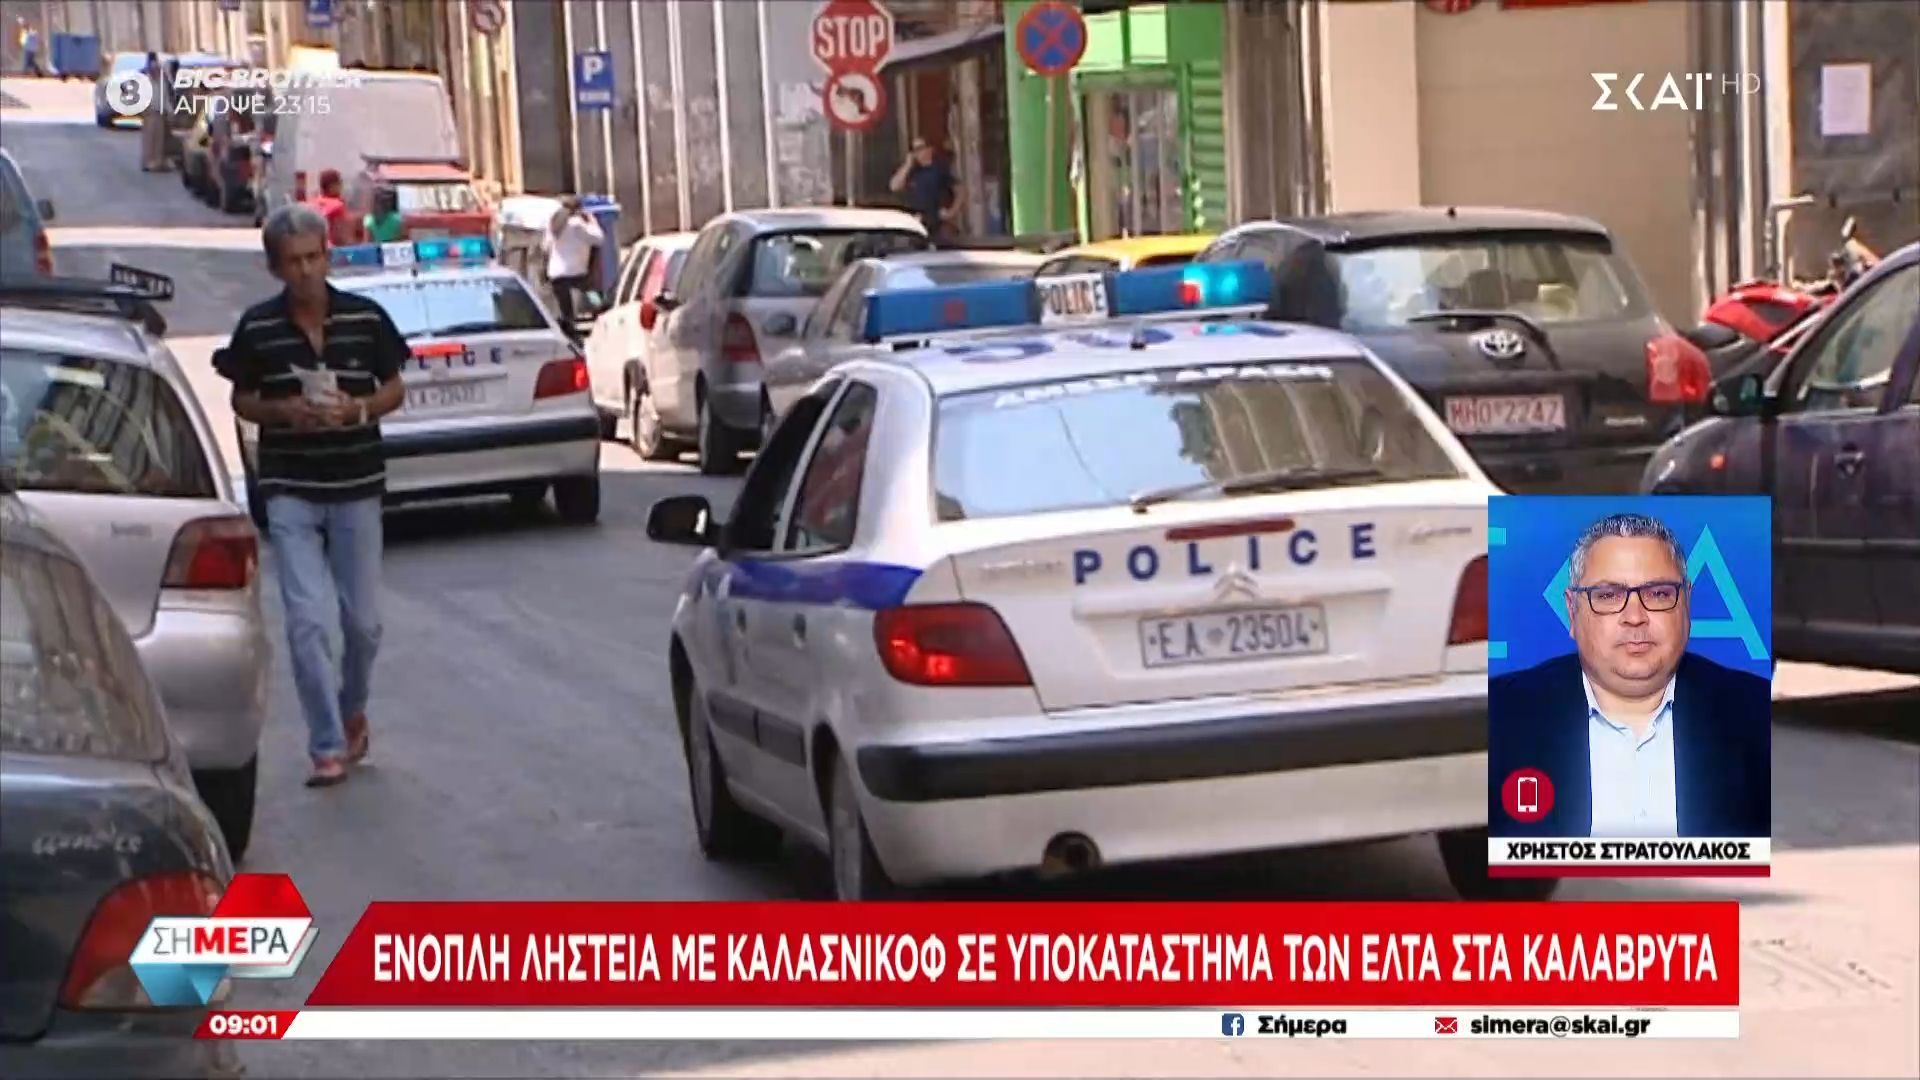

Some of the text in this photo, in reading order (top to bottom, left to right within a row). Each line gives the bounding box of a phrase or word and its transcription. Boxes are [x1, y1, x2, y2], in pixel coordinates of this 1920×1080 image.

[817, 16, 884, 58] STOP
[583, 55, 604, 83] P
[1036, 280, 1104, 315] POLICE
[1073, 522, 1376, 585] POLICE
[1226, 609, 1311, 654] 23504
